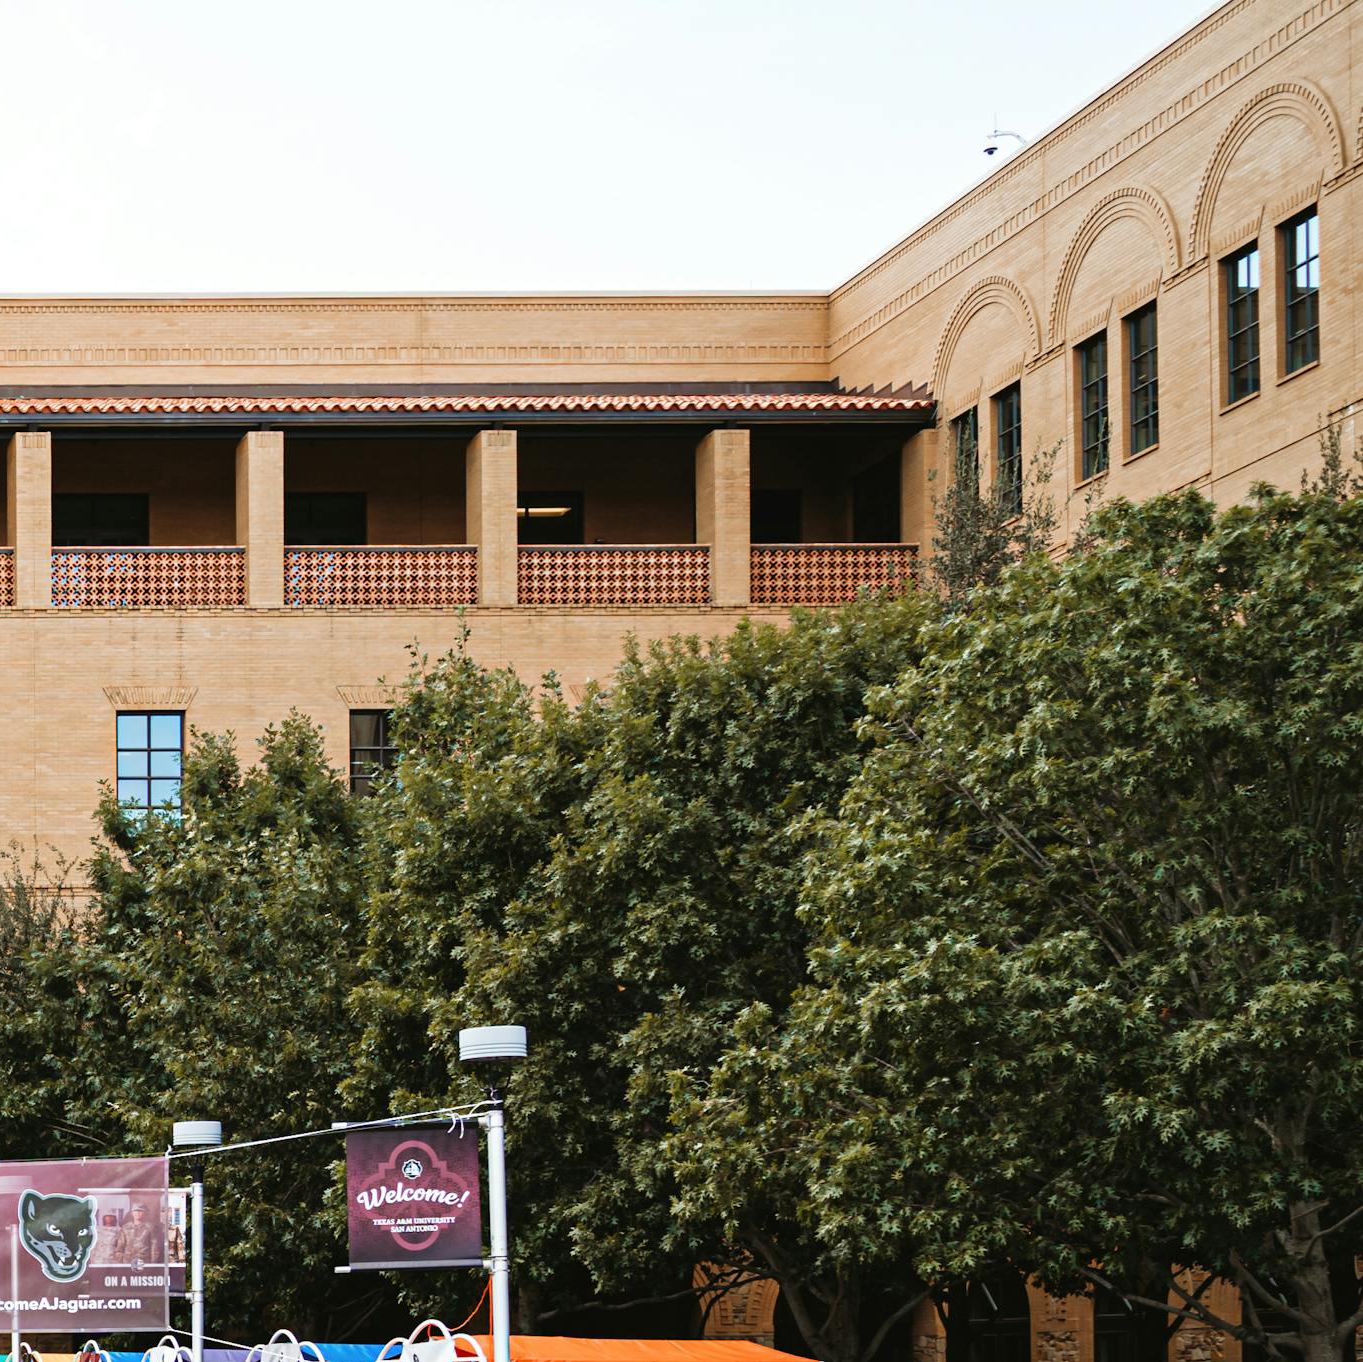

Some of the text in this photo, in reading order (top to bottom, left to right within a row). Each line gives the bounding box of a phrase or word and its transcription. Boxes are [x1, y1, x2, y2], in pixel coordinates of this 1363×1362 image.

[356, 1182, 470, 1211] Welcome!
[372, 1216, 456, 1226] TEXAS A&M UNIVERSITY
[390, 1225, 405, 1233] SAN
[104, 1276, 171, 1287] ON A MISSION
